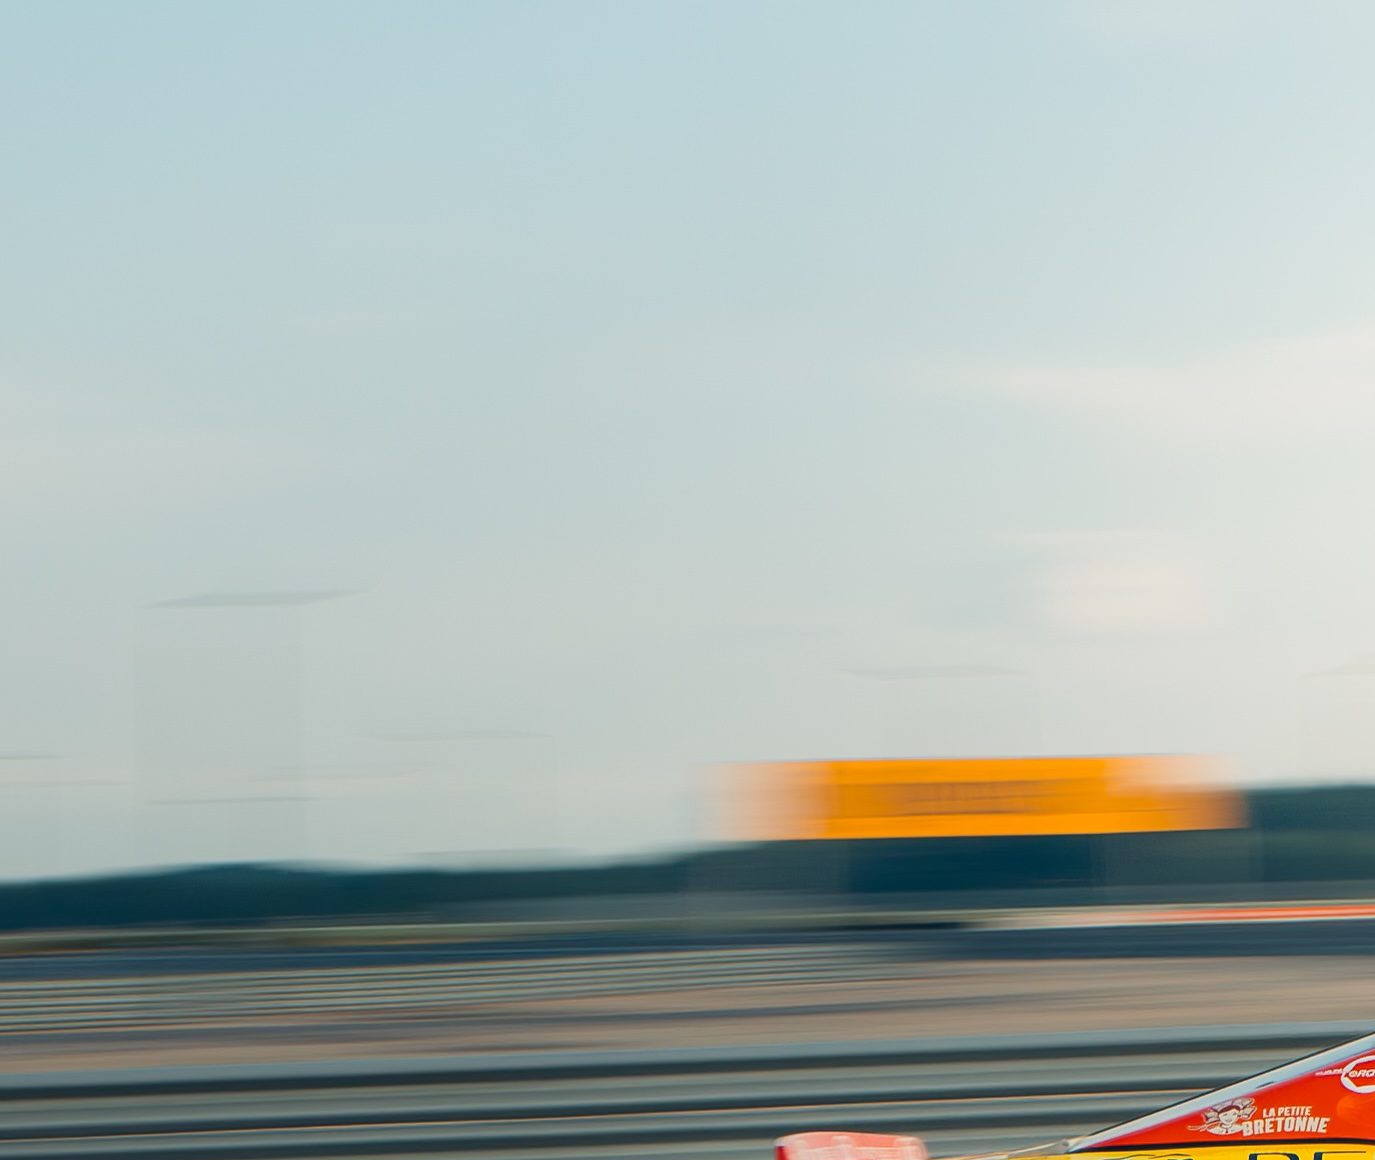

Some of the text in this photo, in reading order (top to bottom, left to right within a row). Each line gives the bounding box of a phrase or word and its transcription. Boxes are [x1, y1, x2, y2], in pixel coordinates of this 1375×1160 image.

[1262, 1106, 1312, 1118] LA PETITE
[1242, 1116, 1331, 1136] BRETONNE
